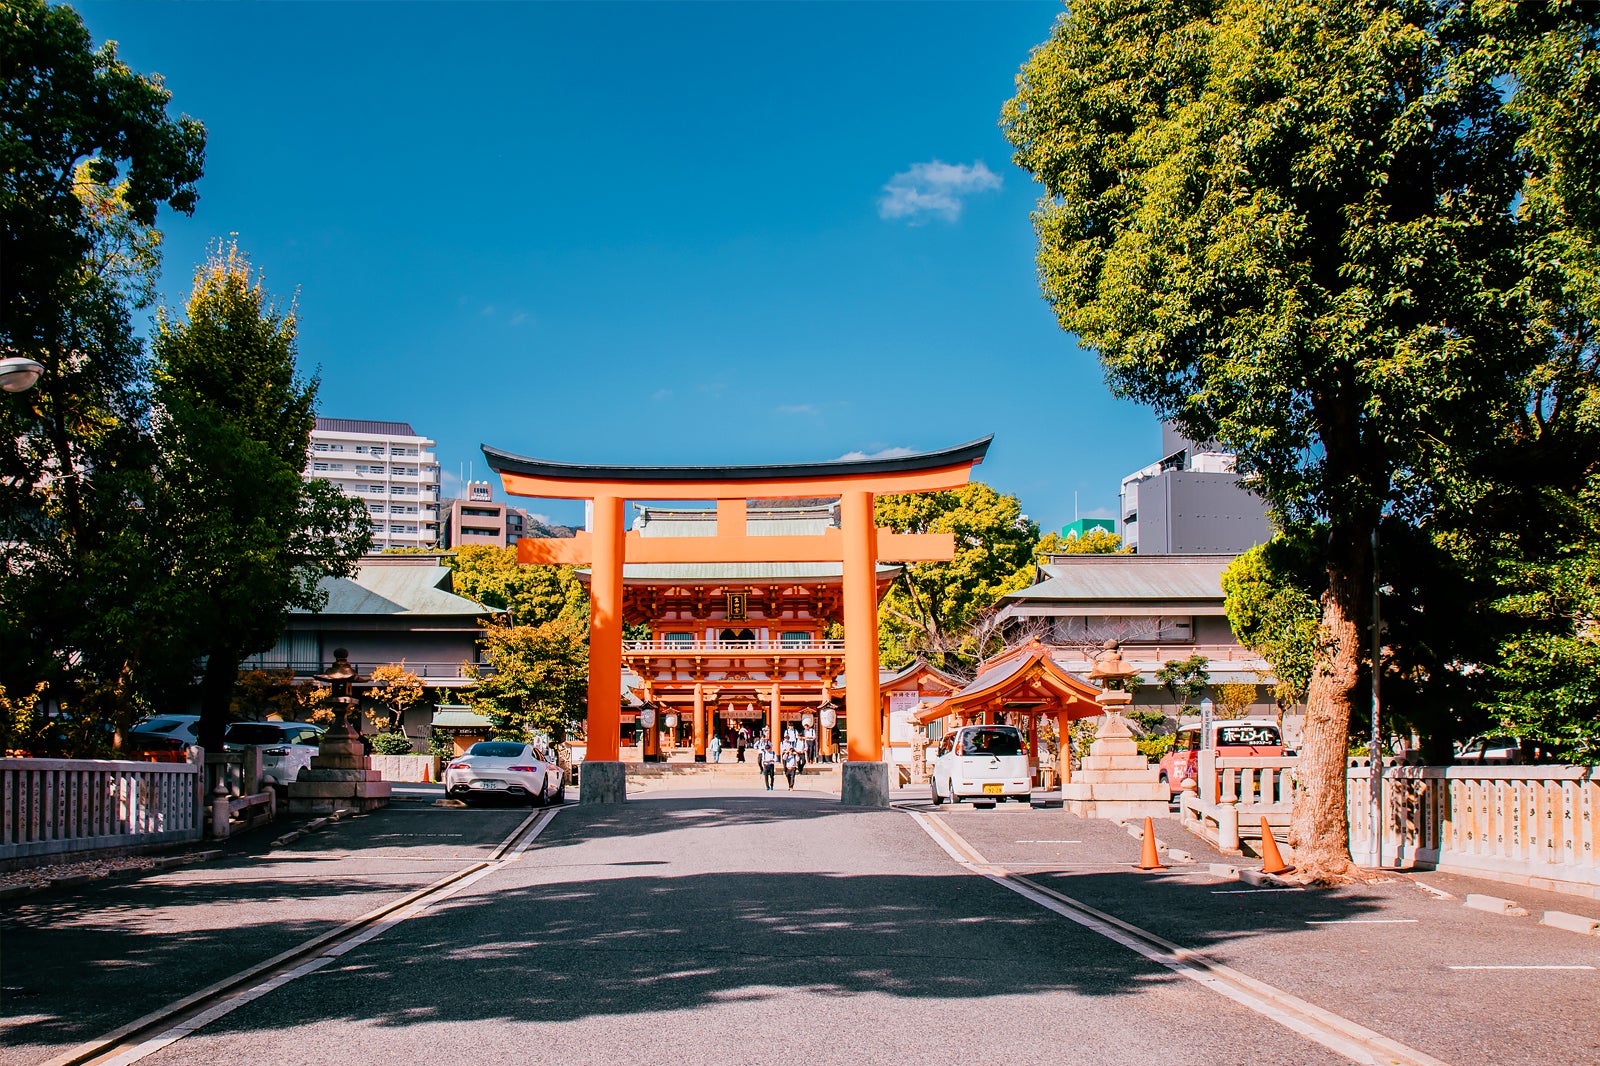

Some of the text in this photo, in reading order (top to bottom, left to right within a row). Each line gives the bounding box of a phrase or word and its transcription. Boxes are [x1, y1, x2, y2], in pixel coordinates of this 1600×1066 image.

[1225, 731, 1273, 742] ホームメイト
